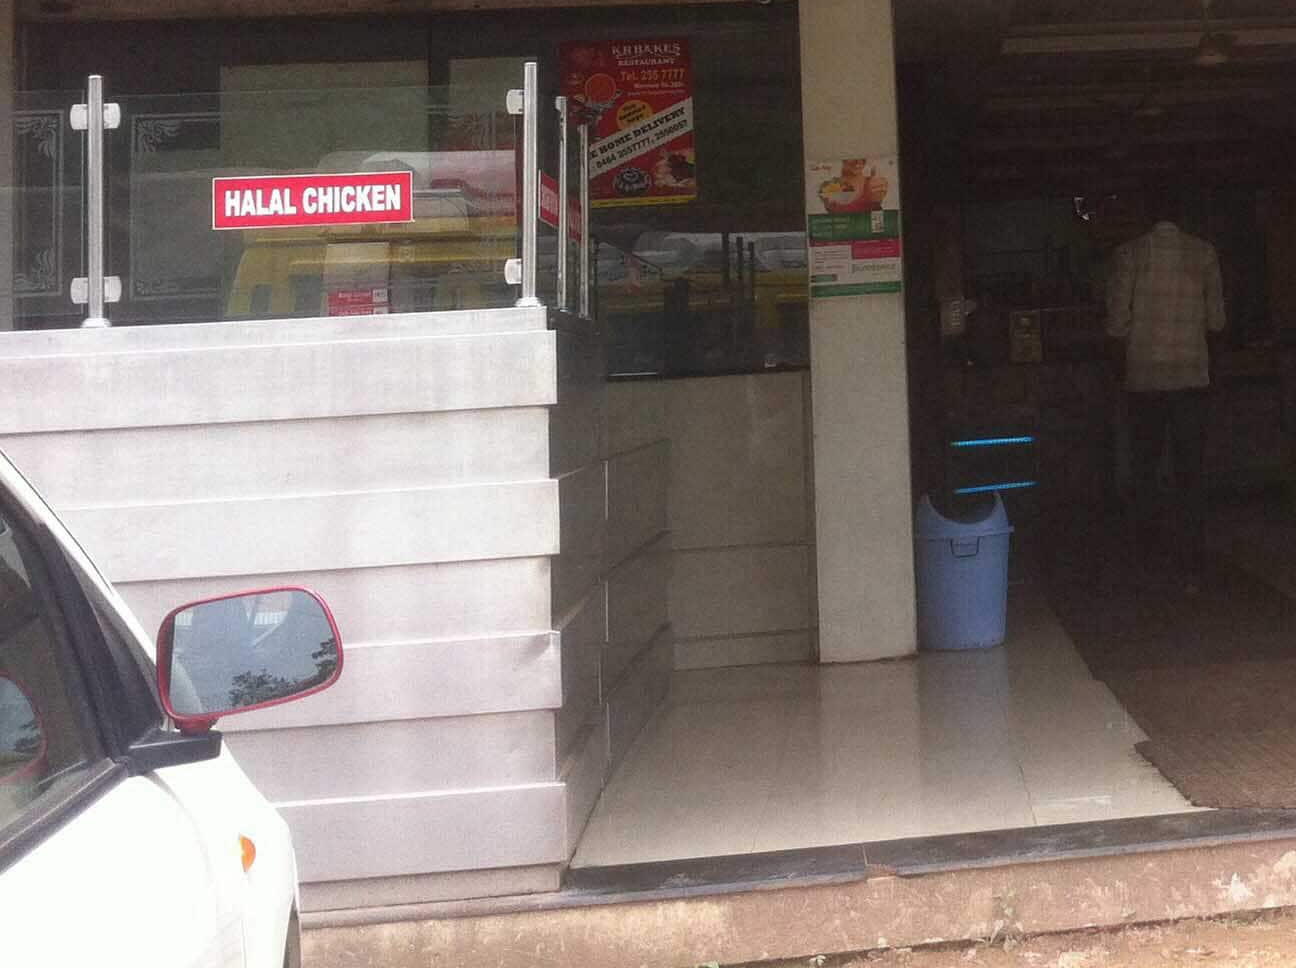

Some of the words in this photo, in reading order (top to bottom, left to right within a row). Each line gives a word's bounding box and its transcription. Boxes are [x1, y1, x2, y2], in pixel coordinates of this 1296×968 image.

[599, 133, 632, 154] HOME
[632, 107, 685, 138] DELIVERY
[224, 188, 297, 217] HALAL
[302, 184, 401, 214] CHICKEN
